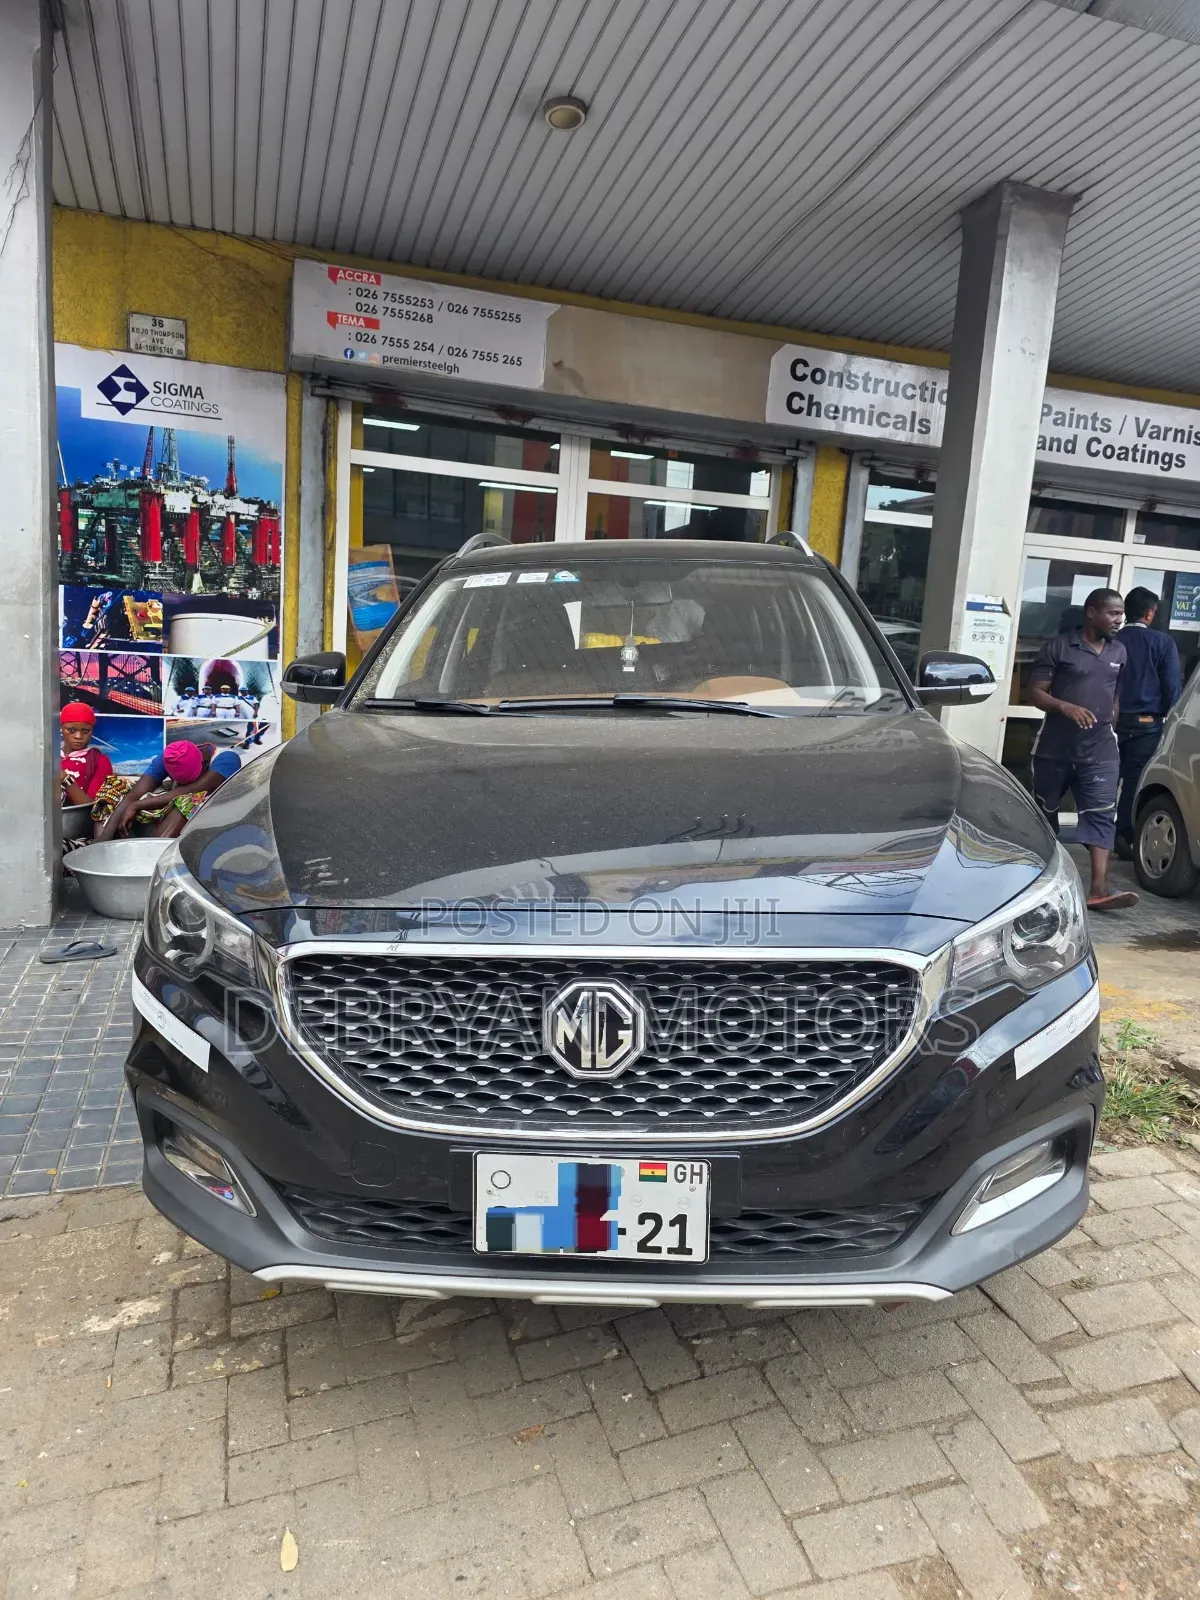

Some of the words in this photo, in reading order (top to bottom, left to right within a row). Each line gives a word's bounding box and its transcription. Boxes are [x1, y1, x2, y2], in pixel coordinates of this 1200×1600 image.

[336, 269, 377, 284] ACCRA
[355, 287, 378, 300] 026
[382, 292, 434, 309] 7555253
[437, 301, 444, 312] /
[447, 302, 468, 315] 026
[472, 306, 522, 324] 7555255
[355, 302, 378, 315] 026
[382, 306, 434, 324] 7555268
[131, 326, 148, 335] KOJO
[152, 318, 164, 328] 36
[337, 314, 366, 328] TEMA
[355, 332, 378, 344] 026
[381, 336, 410, 349] 7555
[413, 340, 434, 353] 254
[438, 344, 444, 356] /
[447, 346, 468, 358] 026
[472, 350, 499, 363] 7555
[502, 354, 522, 366] 265
[382, 355, 460, 374] premiersteelgh
[152, 381, 204, 400] SIGMA
[150, 396, 219, 414] COATINGS
[786, 391, 932, 435] Chemicals
[1040, 403, 1112, 434] Paints
[1118, 414, 1128, 436] /
[1036, 434, 1078, 455] and
[1086, 436, 1187, 472] Coatings
[1174, 610, 1196, 618] INVOICE
[1176, 601, 1192, 610] VAT
[556, 991, 633, 1069] MG
[673, 1163, 704, 1185] GH
